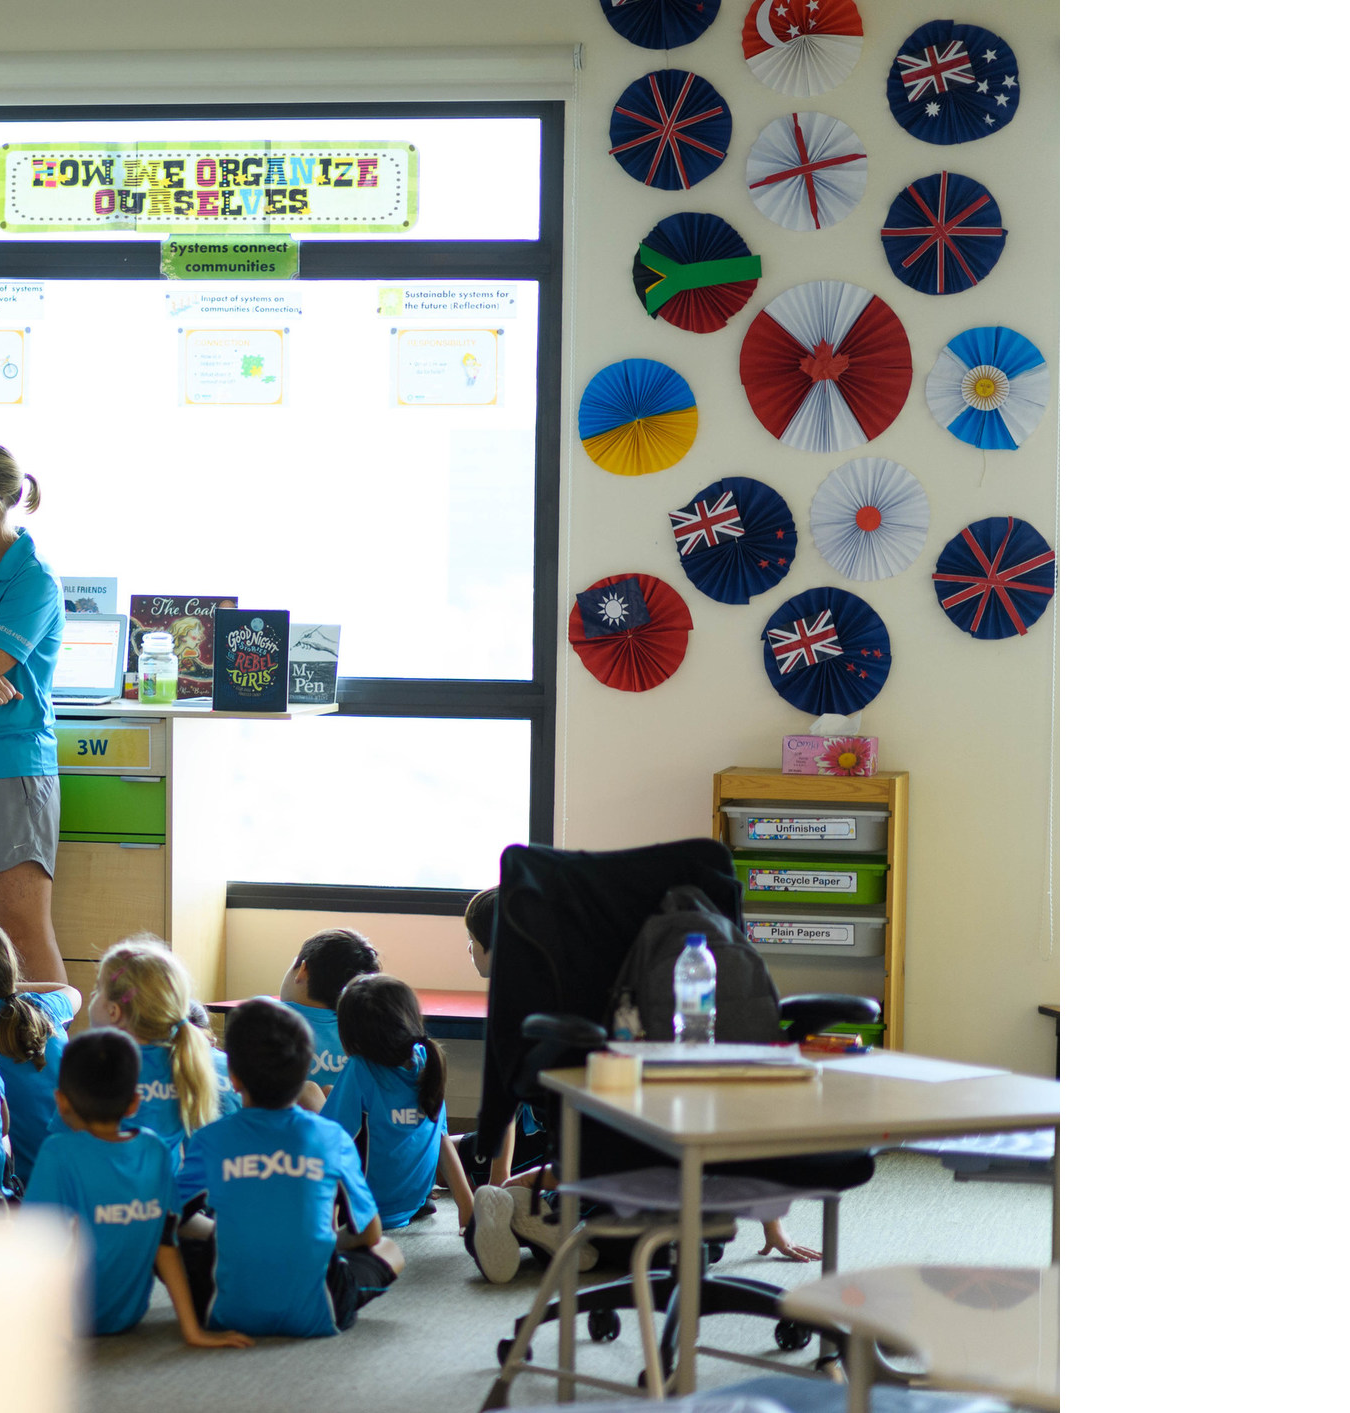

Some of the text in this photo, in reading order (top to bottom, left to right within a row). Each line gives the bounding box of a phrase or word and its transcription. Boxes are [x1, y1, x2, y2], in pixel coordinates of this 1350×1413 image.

[32, 156, 380, 189] HOW WE ORGANIZE
[93, 188, 311, 217] OURSELVES
[169, 241, 289, 255] Systems connect
[185, 259, 276, 272] communities
[0, 284, 8, 292] of
[12, 285, 43, 294] systems
[405, 290, 509, 300] Sustainable systems for
[201, 295, 229, 304] Impact
[230, 294, 239, 302] of
[240, 295, 272, 304] systems
[405, 302, 419, 310] the
[421, 302, 448, 310] future
[200, 305, 250, 313] communities
[77, 586, 107, 594] FRIENDS
[151, 597, 179, 616] The
[235, 651, 277, 673] REBEL
[292, 663, 314, 682] My
[294, 678, 324, 693] Pen
[77, 739, 108, 756] 3W
[776, 824, 827, 833] Unfinished
[773, 875, 841, 887] Recycle Paper
[771, 927, 831, 938] Plain Papers
[136, 1080, 178, 1102] EXUS
[223, 1150, 325, 1182] NEXUS
[95, 1199, 163, 1225] NEXUS
